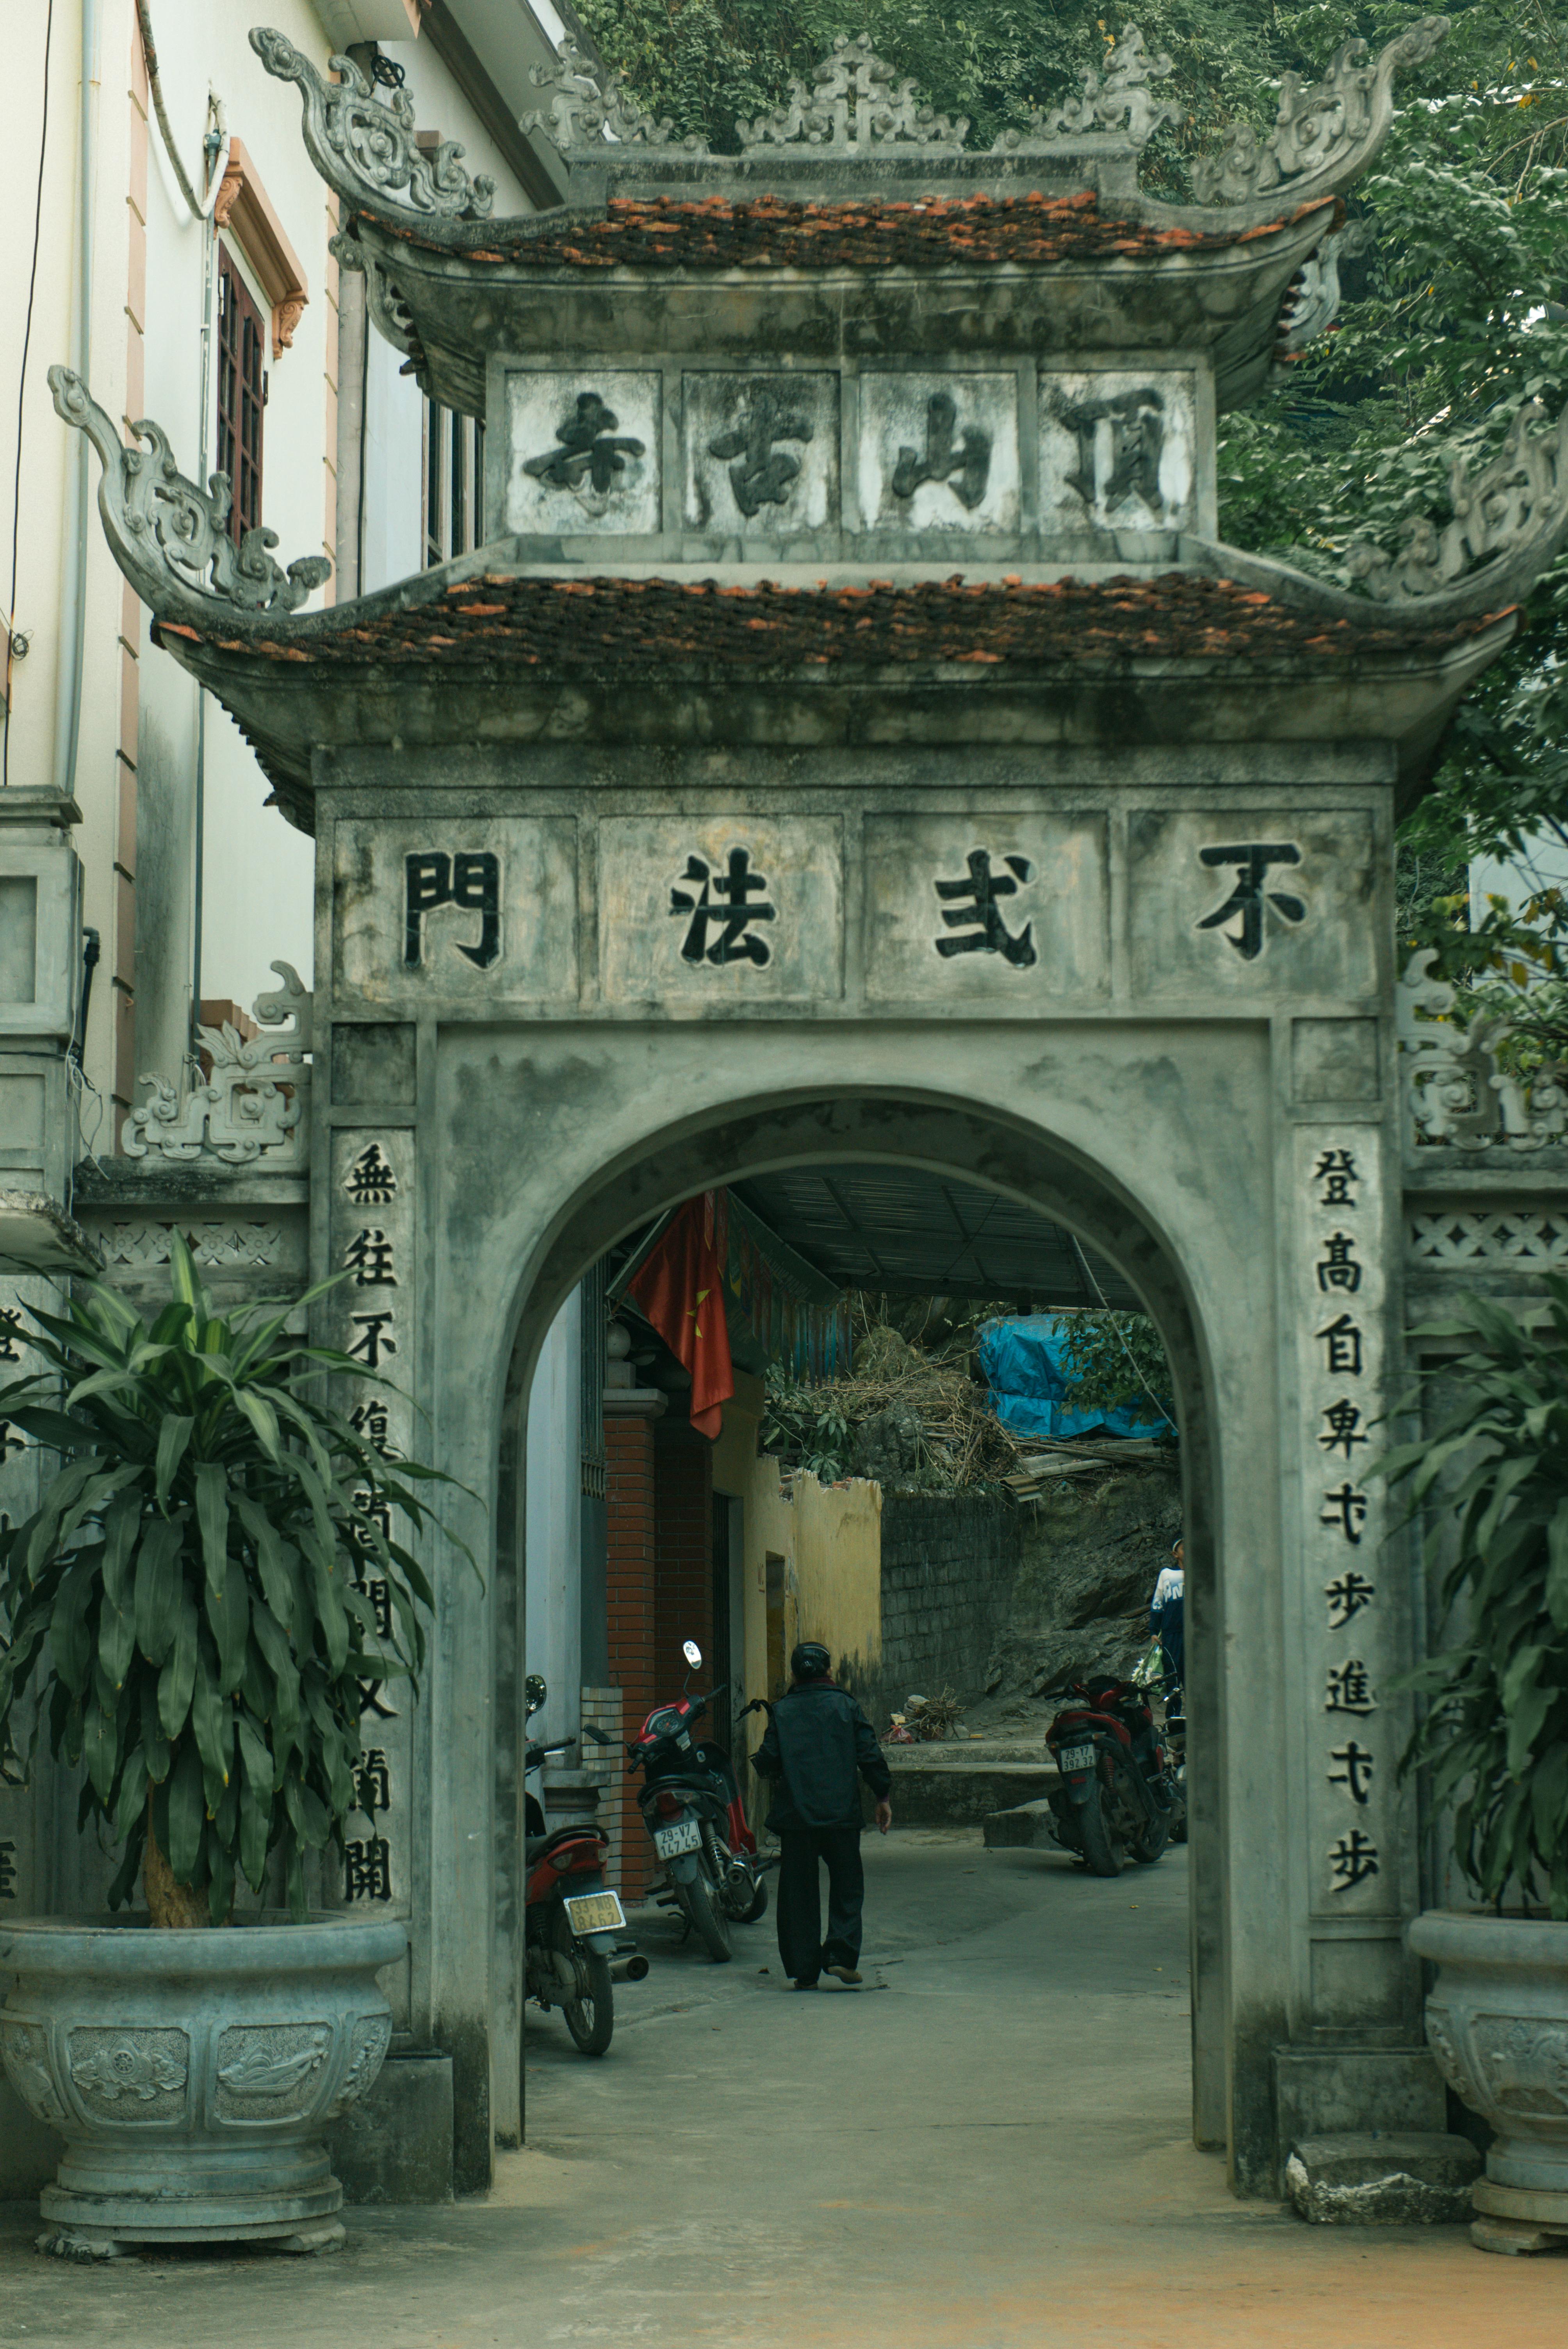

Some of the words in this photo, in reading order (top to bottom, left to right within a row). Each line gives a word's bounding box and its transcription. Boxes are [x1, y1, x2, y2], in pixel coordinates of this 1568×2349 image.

[1066, 1746, 1089, 1760] 29-Y7
[1064, 1756, 1093, 1770] 392.32
[661, 1823, 690, 1843] 29-V7
[661, 1835, 698, 1857] 147.45
